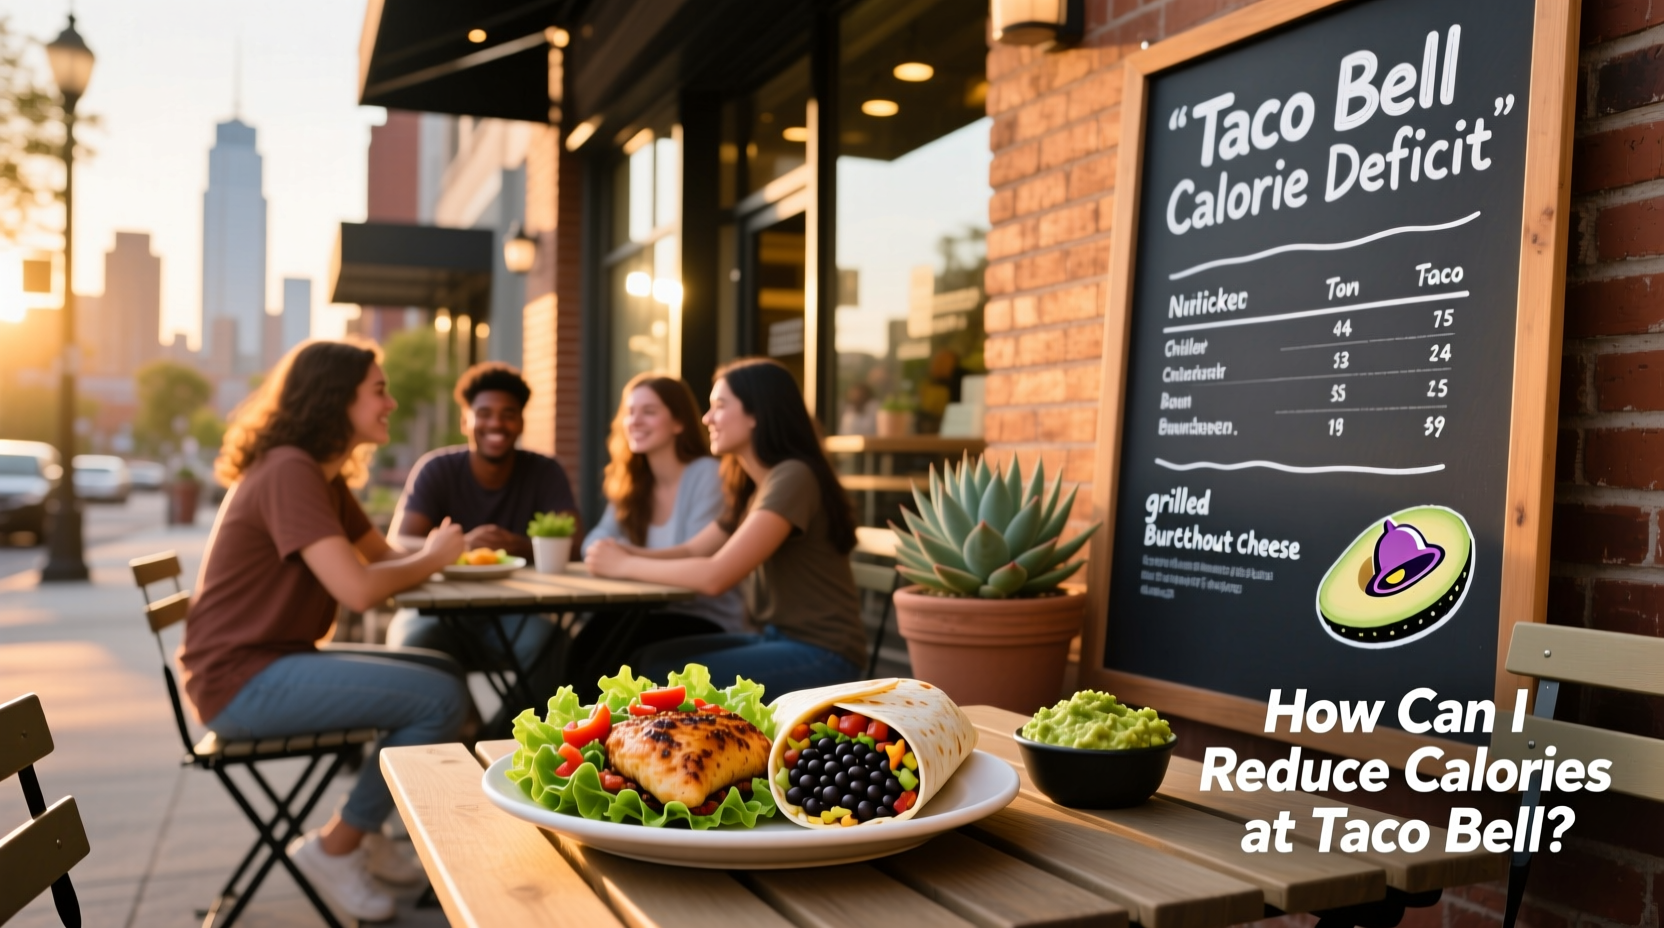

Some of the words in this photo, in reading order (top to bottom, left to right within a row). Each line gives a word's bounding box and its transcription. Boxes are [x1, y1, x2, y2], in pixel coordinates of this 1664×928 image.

[1333, 24, 1462, 132] Bell
[1166, 159, 1309, 236] Calorie
[1415, 262, 1464, 287] Taco
[1333, 318, 1353, 338] 44
[1433, 308, 1455, 329] 75
[1429, 343, 1452, 363] 24
[1427, 378, 1449, 399] 25
[1144, 486, 1211, 525] grilled
